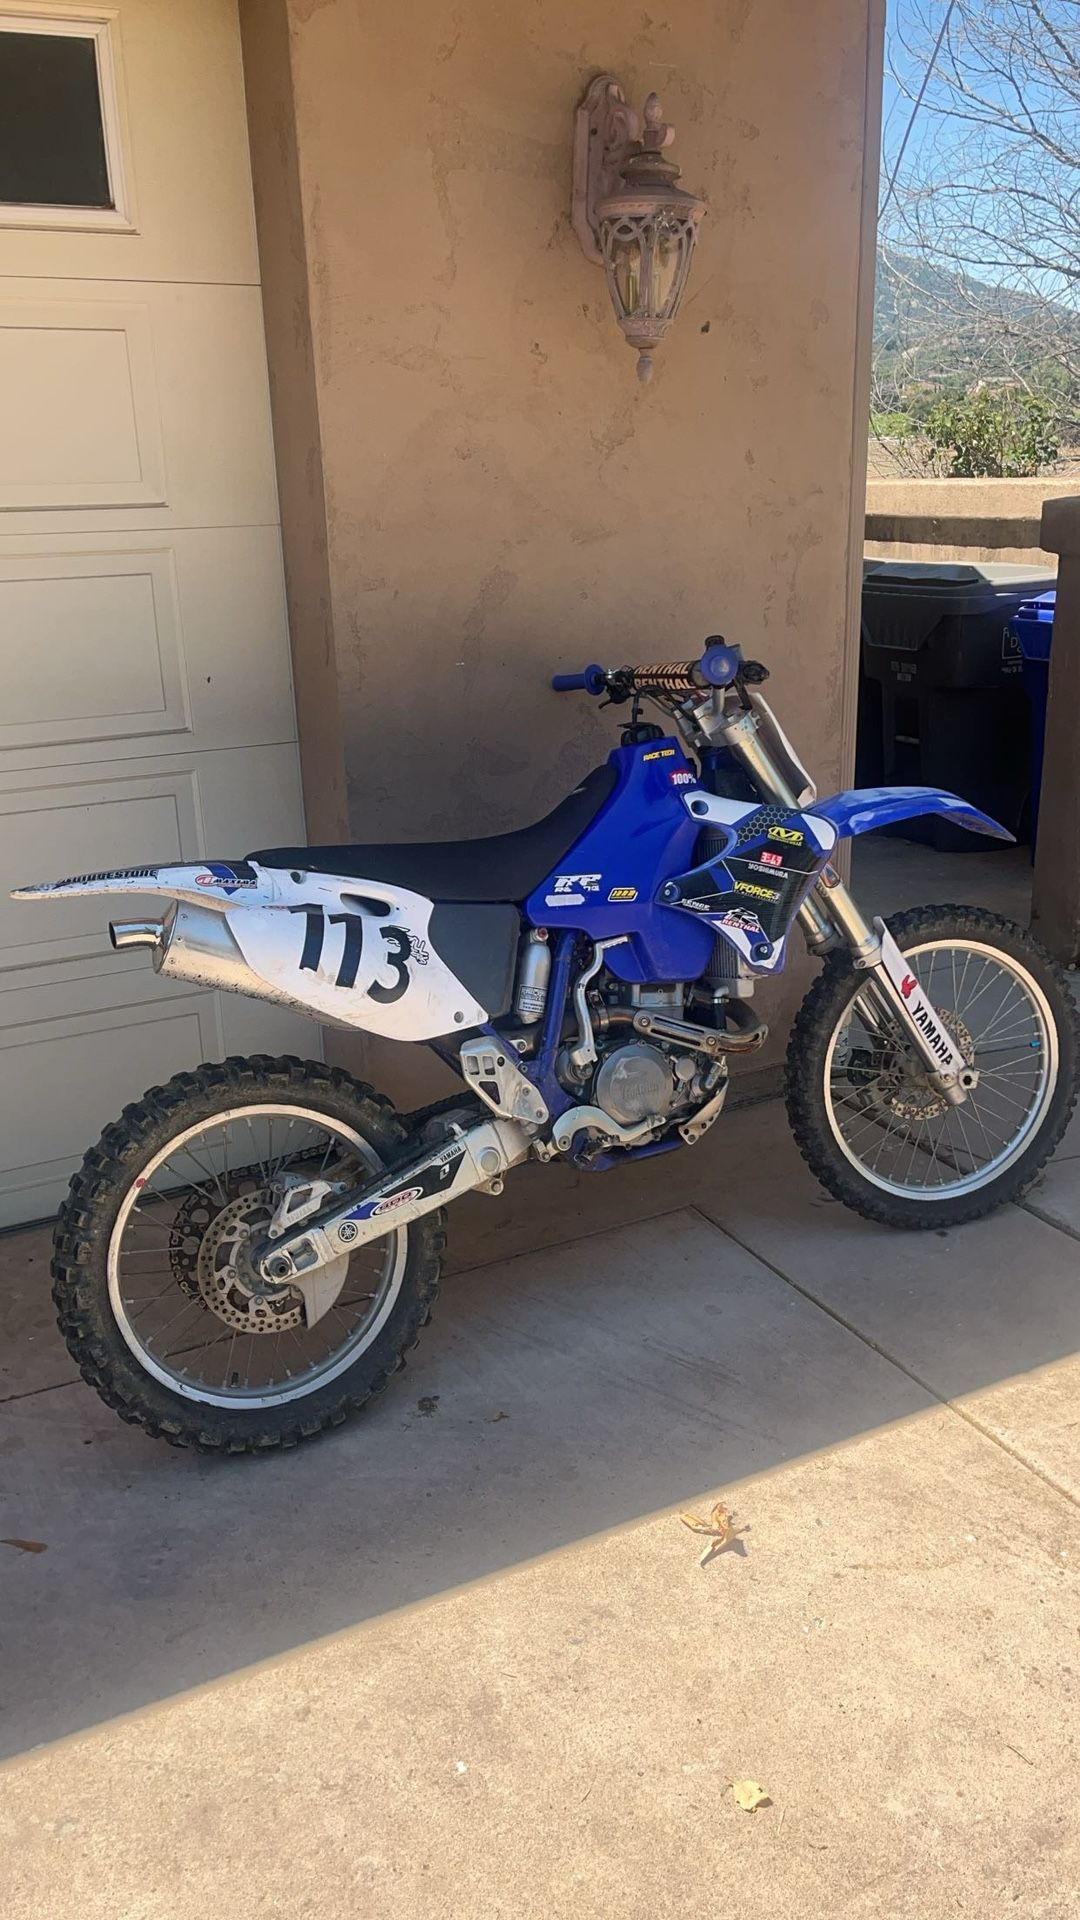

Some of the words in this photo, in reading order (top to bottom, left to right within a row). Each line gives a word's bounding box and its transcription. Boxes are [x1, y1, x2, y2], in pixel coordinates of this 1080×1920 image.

[634, 677, 697, 690] RENTHAL
[672, 773, 697, 785] 100%
[747, 863, 789, 880] YOSHIMURA
[722, 918, 760, 933] RENTHAL
[912, 1000, 954, 1066] YAMAHA
[440, 1146, 462, 1163] YAMAHA
